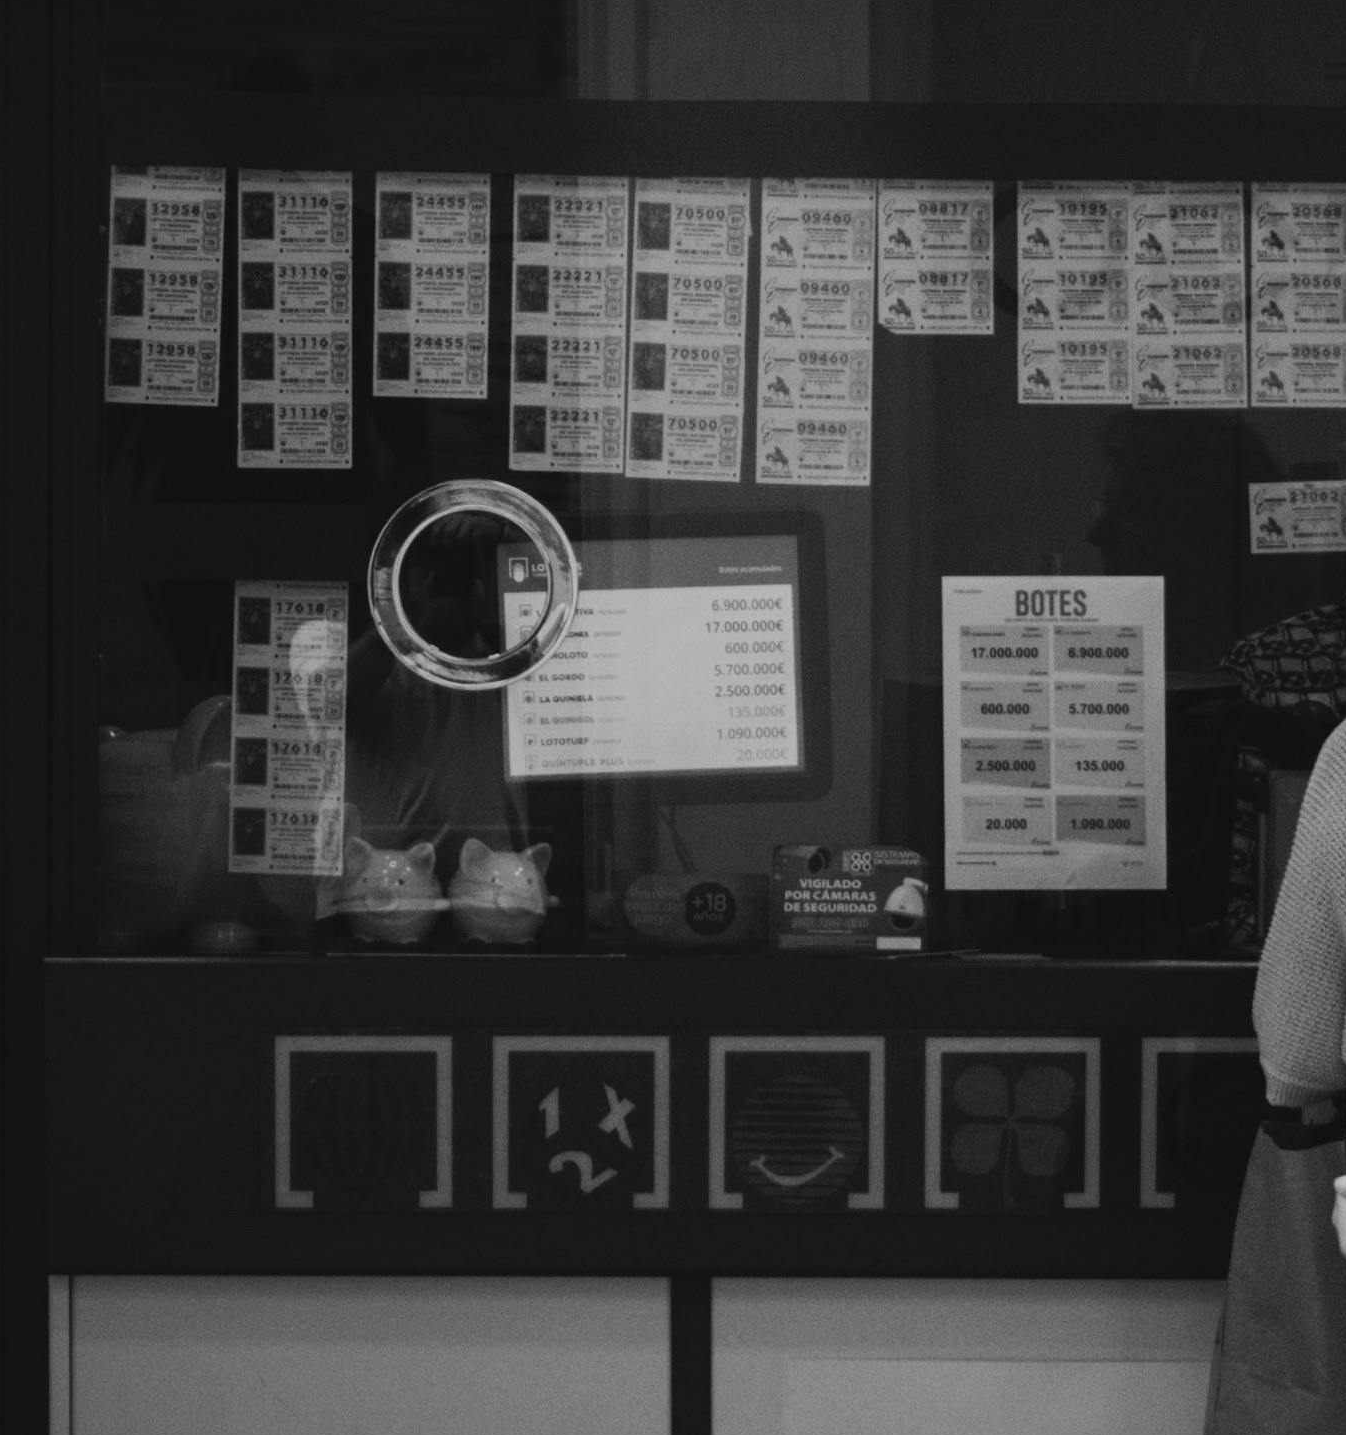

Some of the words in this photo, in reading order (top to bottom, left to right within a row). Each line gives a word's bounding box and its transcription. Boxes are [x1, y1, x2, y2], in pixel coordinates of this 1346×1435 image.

[1015, 589, 1088, 617] BOTES
[971, 647, 1039, 660] 17.000.000
[1068, 647, 1130, 660] 6.900.000
[980, 703, 1031, 716] 600.000
[1068, 703, 1131, 716] 5.700.000
[975, 760, 1038, 772] 2.500.000
[1075, 760, 1126, 772] 135.000
[985, 818, 1028, 831] 20.000
[1070, 818, 1132, 831] 1.090.000
[798, 878, 862, 889] VIGILADO
[784, 890, 813, 901] POR
[813, 887, 877, 902] CÁMARAS
[784, 902, 803, 913] DE
[803, 902, 878, 914] SEGURIDAD
